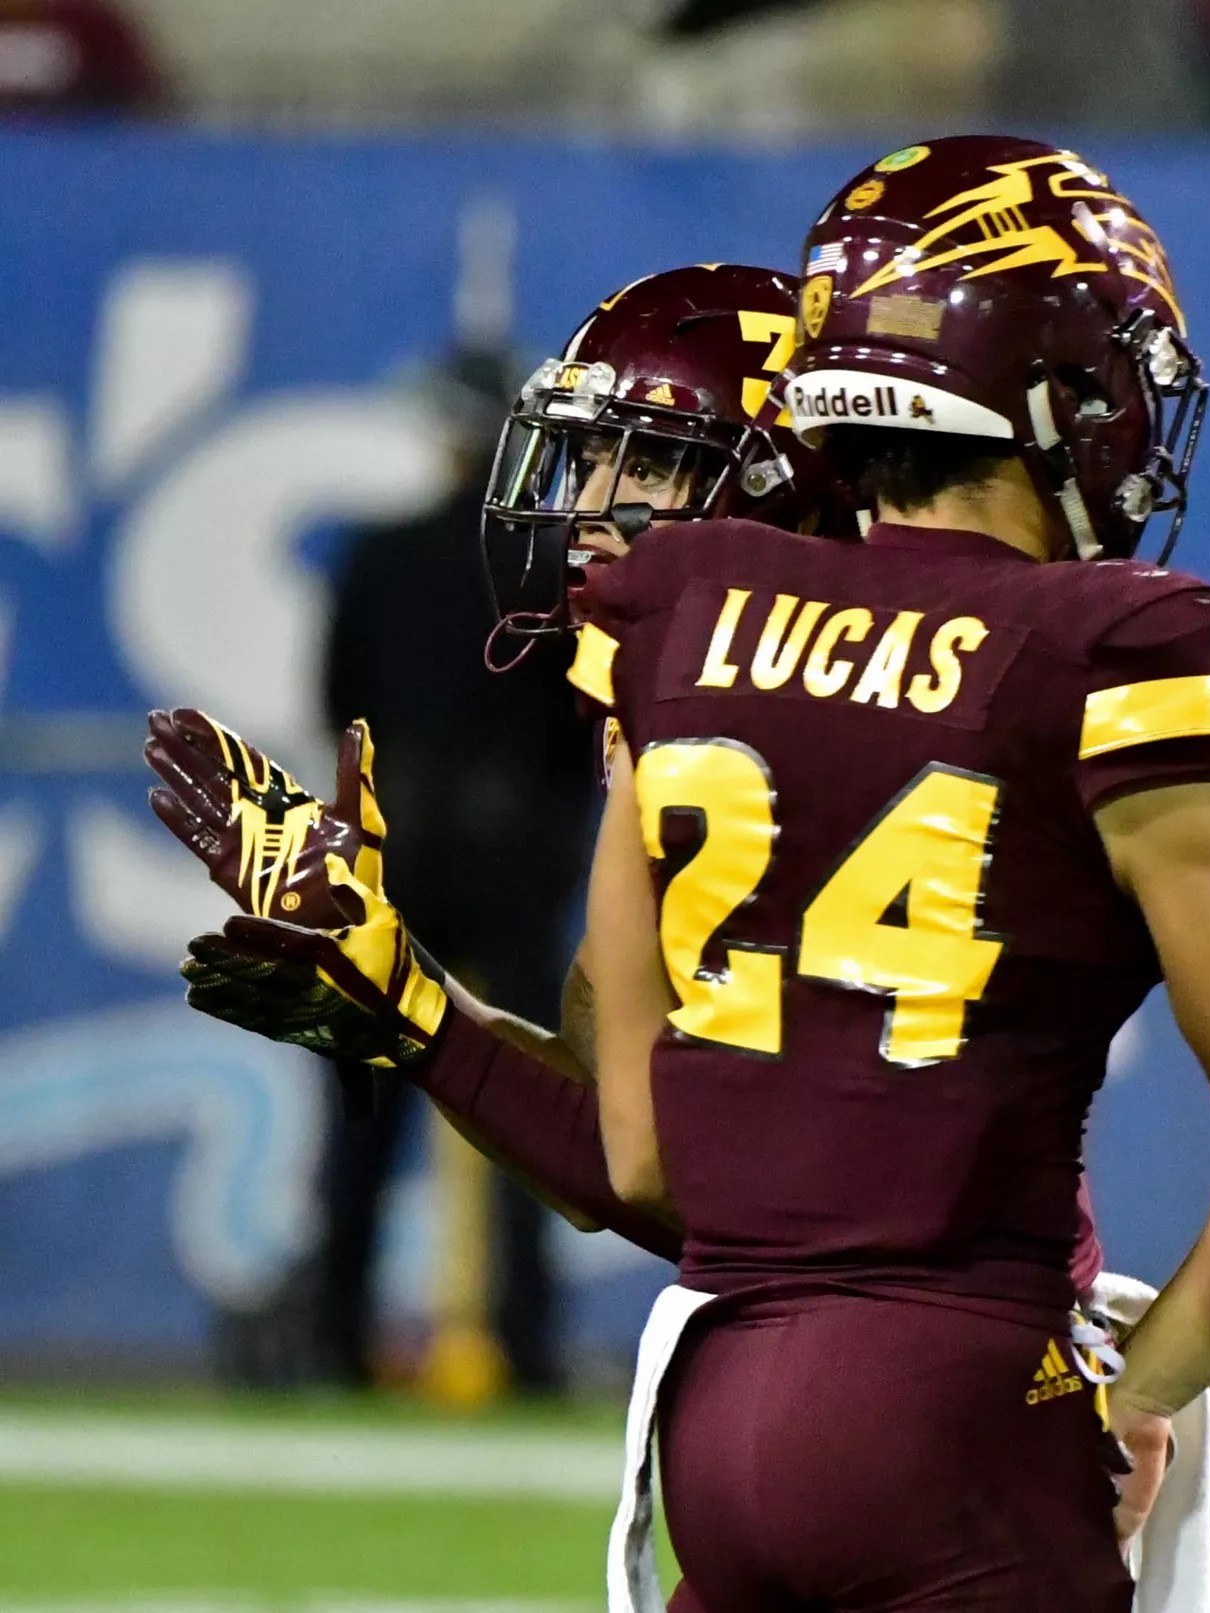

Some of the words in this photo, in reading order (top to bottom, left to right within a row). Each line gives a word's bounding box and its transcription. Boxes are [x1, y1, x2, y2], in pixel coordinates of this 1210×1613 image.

[794, 386, 899, 417] Riddell
[696, 588, 990, 714] LUCAS
[635, 736, 1006, 1068] 24
